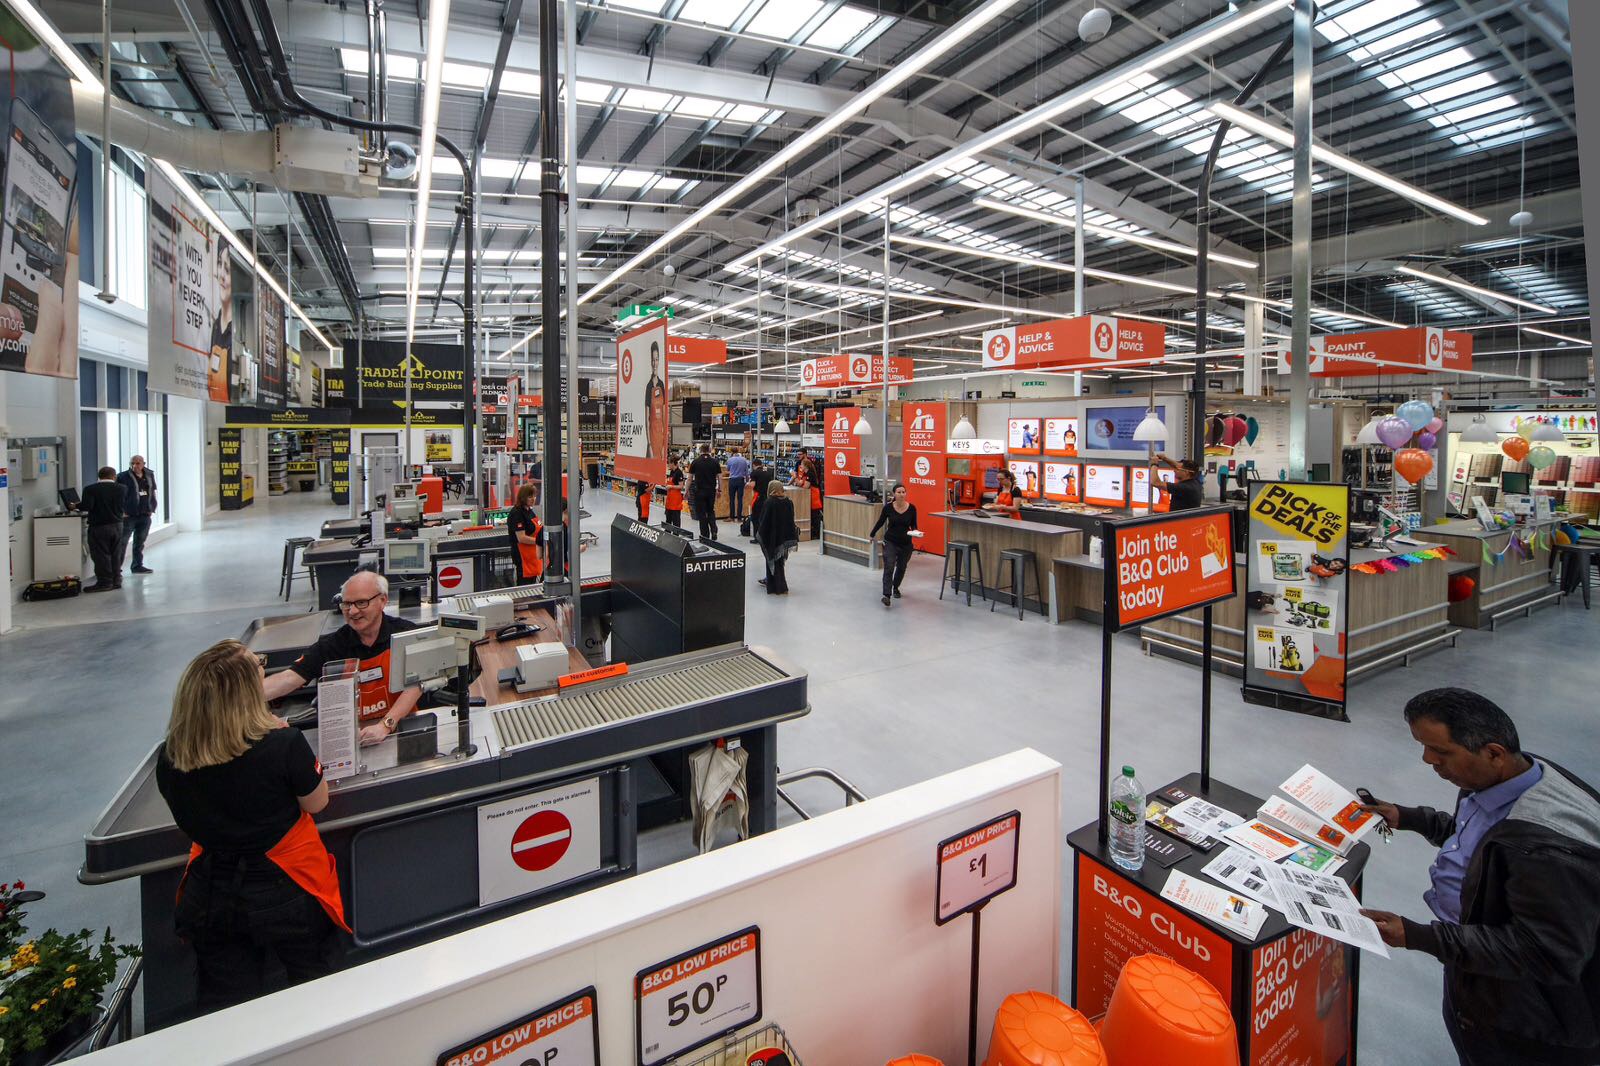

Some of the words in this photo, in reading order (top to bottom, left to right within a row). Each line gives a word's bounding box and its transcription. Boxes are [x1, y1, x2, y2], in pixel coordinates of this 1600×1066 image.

[185, 242, 202, 268] WITH
[186, 265, 202, 287] YOU
[183, 285, 206, 310] EVERY
[186, 309, 203, 330] STEP
[1018, 333, 1042, 344] HELP
[1045, 331, 1052, 341] &
[1119, 329, 1136, 340] HELP
[1137, 332, 1143, 341] &
[0, 338, 29, 353] y.com
[668, 345, 686, 354] LLS
[1019, 342, 1054, 354] ADVICE
[1119, 340, 1144, 352] ADVICE
[1327, 341, 1367, 352] PAINT
[1443, 339, 1456, 349] PAINT
[873, 358, 890, 366] CLIK
[1443, 350, 1459, 360] MIXING
[356, 367, 399, 378] TRADE
[424, 370, 464, 380] POINT
[821, 373, 843, 381] RETURNS
[327, 379, 344, 390] TRA
[387, 380, 424, 390] Builing
[426, 381, 463, 391] Supplies
[620, 412, 634, 423] WE'LL
[620, 424, 632, 435] BEAT
[632, 424, 643, 435] ANY
[620, 437, 633, 448] PRICE
[952, 441, 970, 449] KEYS
[909, 478, 936, 486] RETURNS
[1266, 484, 1327, 521] PICK
[1325, 511, 1342, 521] OF
[1255, 498, 1336, 544] DEALS
[1321, 517, 1342, 531] THE
[629, 521, 660, 543] BATTERIES
[1119, 534, 1150, 560] Join
[1154, 530, 1178, 552] the
[686, 558, 745, 573] BATTERIES
[1119, 558, 1153, 586] B&Q
[1156, 551, 1189, 577] Club
[1120, 584, 1165, 611] today
[570, 671, 586, 681] Next
[586, 666, 616, 678] customer
[363, 700, 387, 716] B&Q
[486, 810, 506, 820] Please
[514, 806, 524, 815] not
[541, 799, 552, 807] This
[552, 796, 564, 806] gate
[1110, 803, 1134, 822] Volvic
[943, 842, 963, 857] B&Q
[964, 831, 986, 848] LOW
[986, 818, 1012, 838] PRICE
[969, 853, 987, 878] £1
[1093, 874, 1144, 919] B&Q
[1150, 911, 1211, 962] Club
[1104, 911, 1139, 940] Vouchers
[1104, 921, 1125, 938] every
[1126, 935, 1144, 950] time
[1104, 932, 1128, 953] Digital
[642, 968, 674, 990] B&Q
[675, 953, 708, 978] LOW
[709, 937, 749, 962] PRICE
[1256, 938, 1288, 976] Join
[1256, 957, 1288, 1007] B&Q
[1292, 935, 1323, 970] Club
[1254, 979, 1298, 1034] today
[448, 1046, 488, 1066] B&Q
[492, 1025, 531, 1054] LOW
[536, 1000, 584, 1034] PRICE
